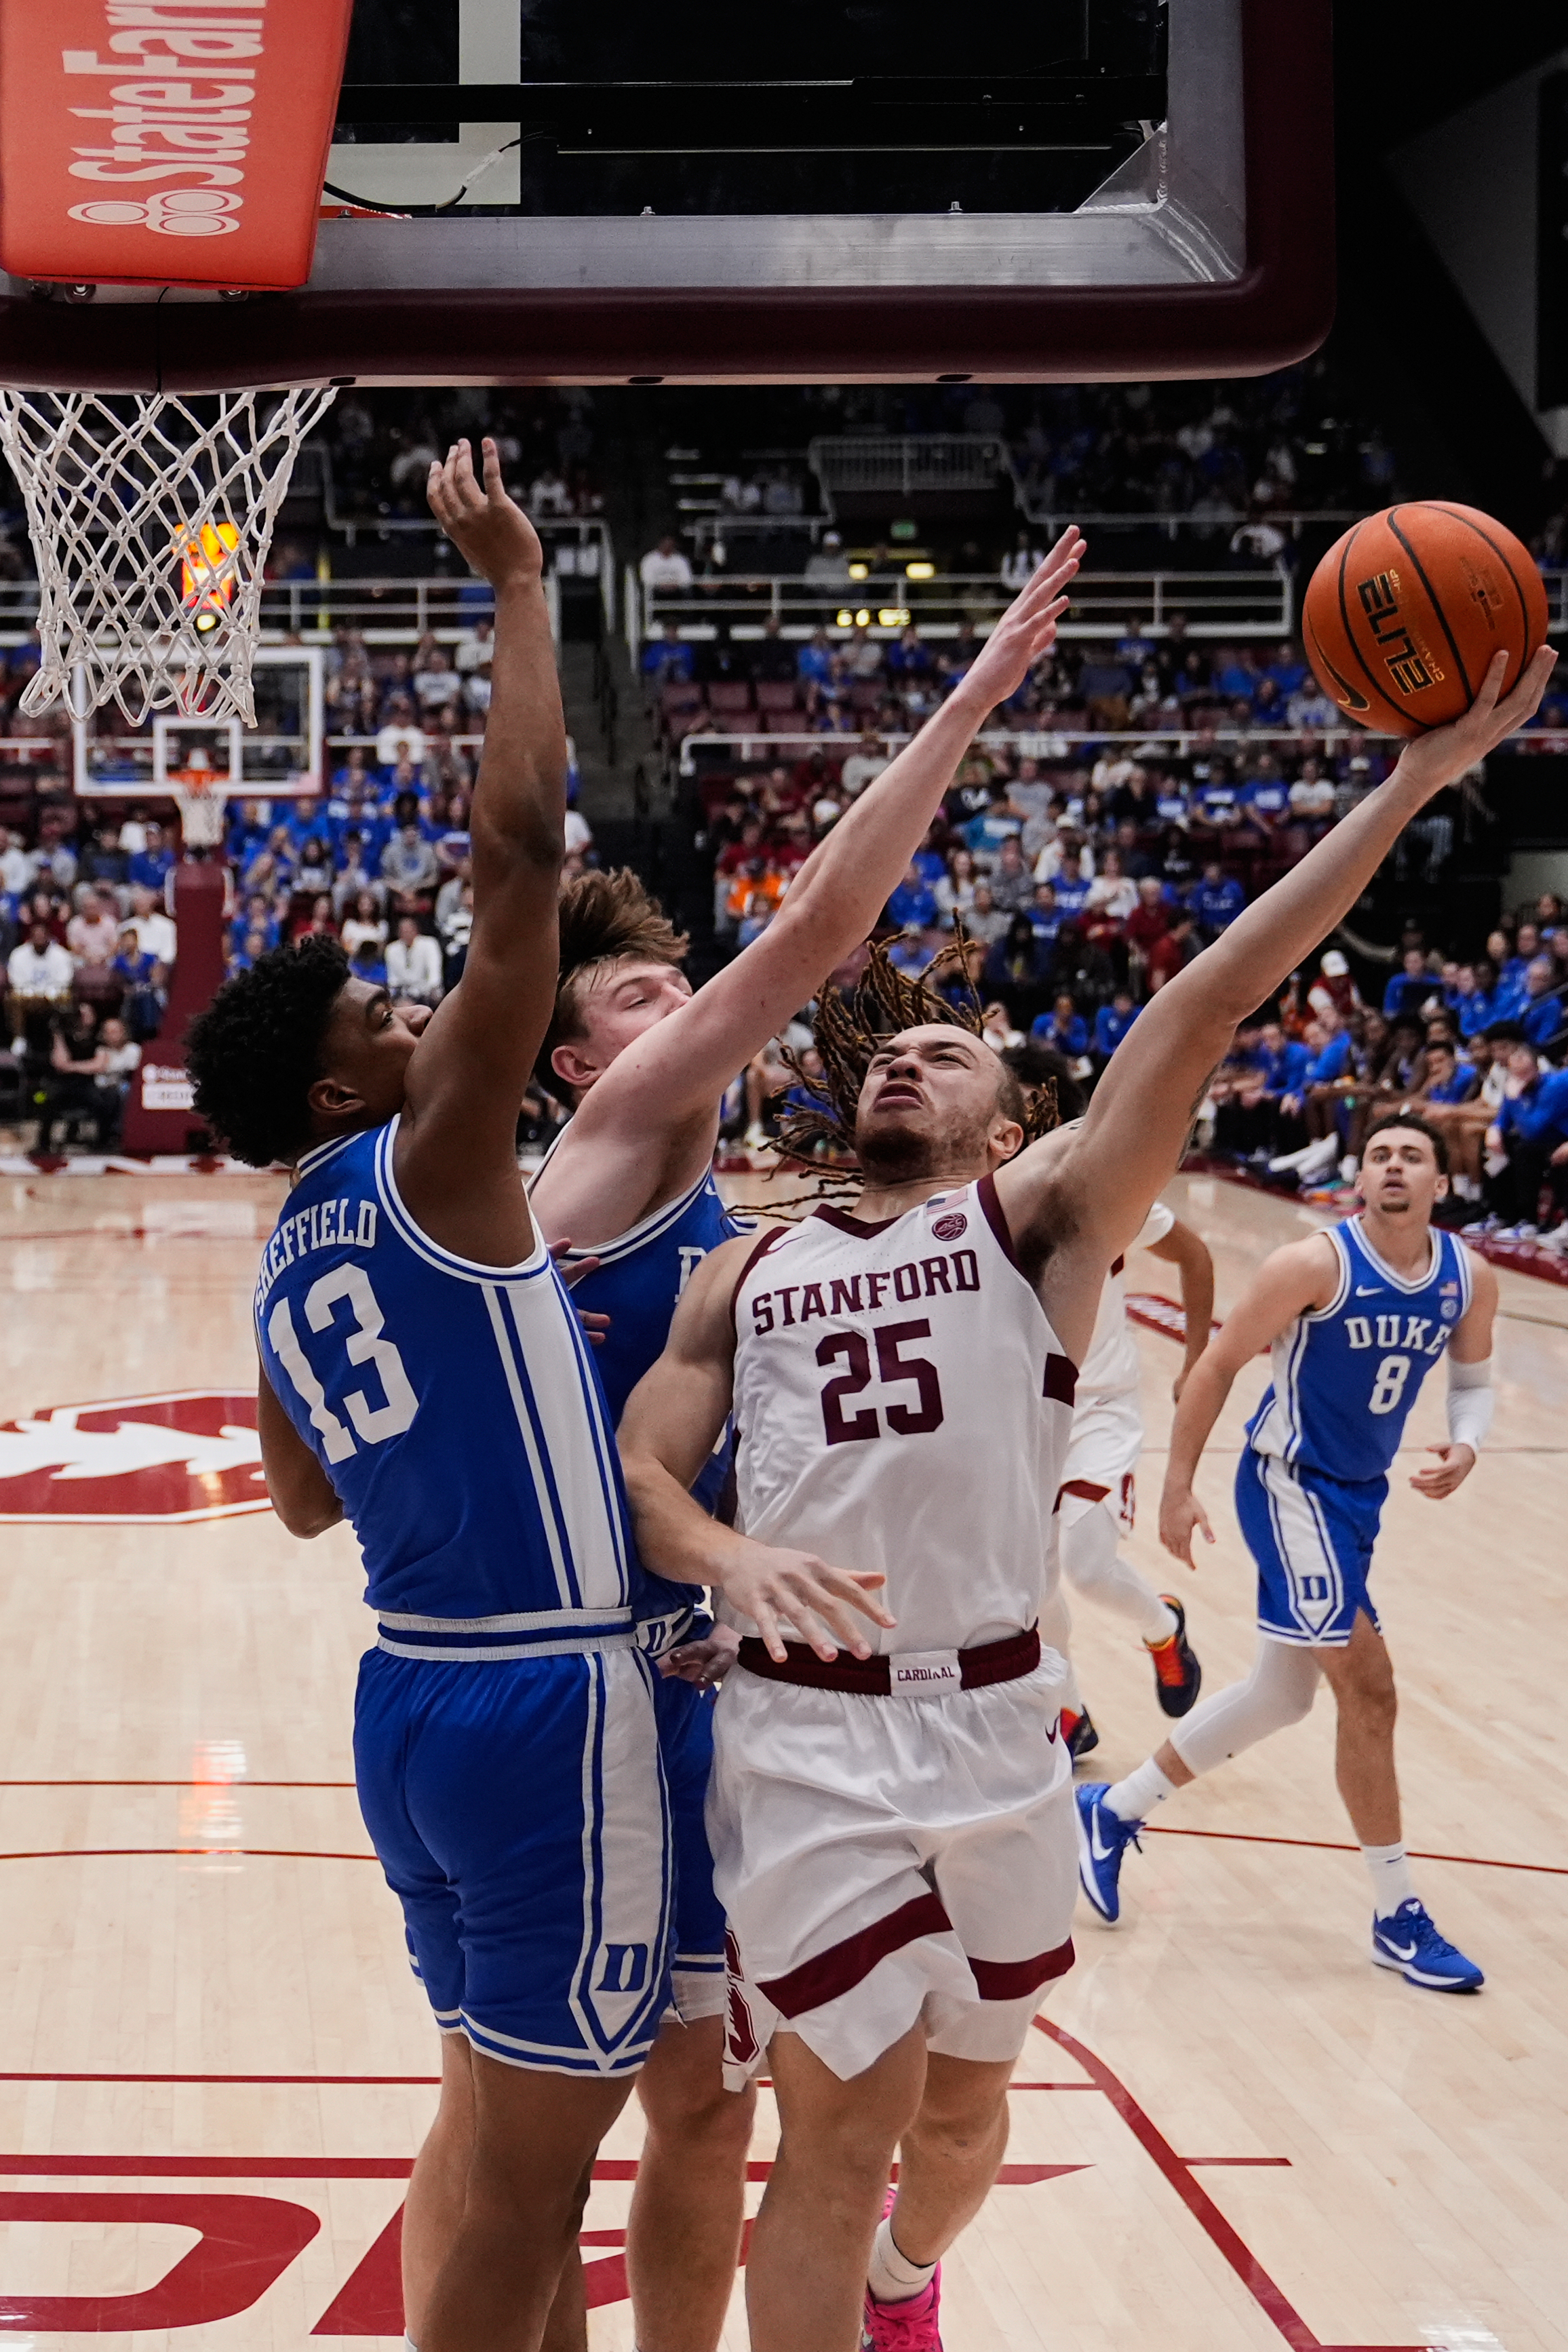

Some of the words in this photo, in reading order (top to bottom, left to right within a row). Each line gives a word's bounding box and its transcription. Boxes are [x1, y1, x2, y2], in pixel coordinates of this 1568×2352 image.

[1356, 571, 1434, 696] ELITE
[752, 1249, 979, 1337] STANFORD
[1344, 1314, 1451, 1355] DUKE
[268, 1262, 419, 1465] 13
[815, 1318, 944, 1446] 25
[1368, 1354, 1411, 1415] 8
[595, 1944, 648, 1991] D
